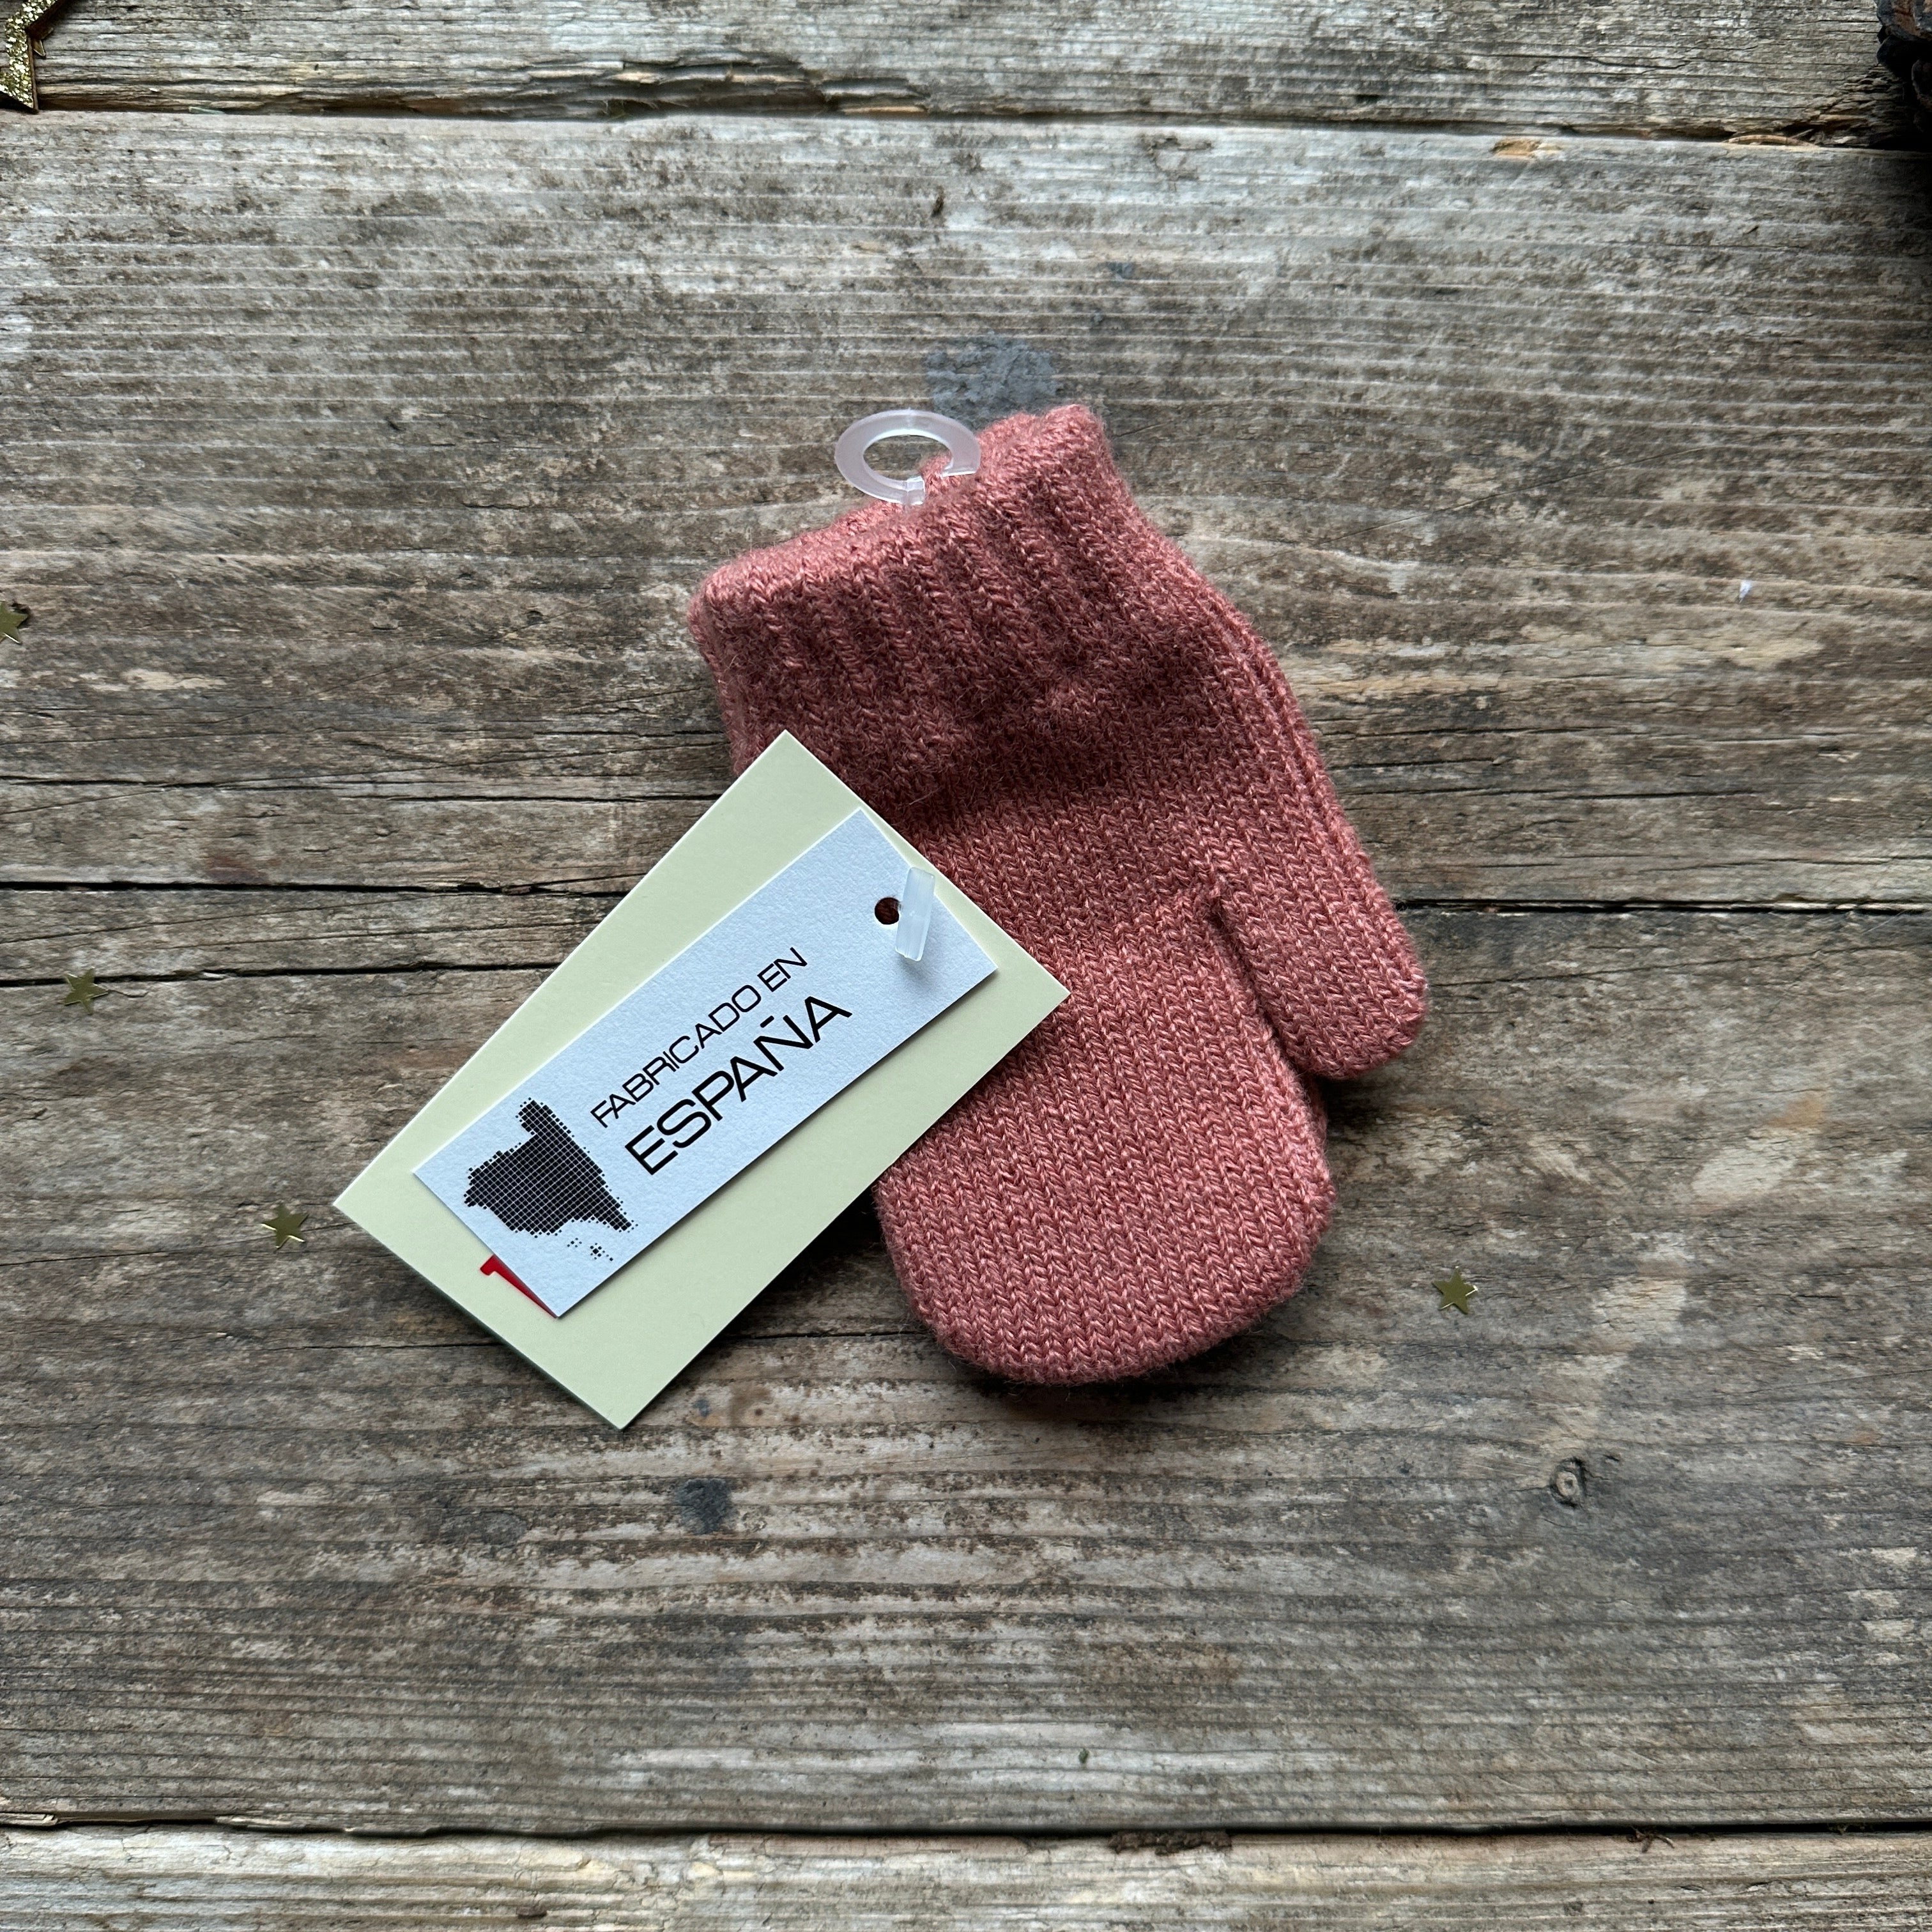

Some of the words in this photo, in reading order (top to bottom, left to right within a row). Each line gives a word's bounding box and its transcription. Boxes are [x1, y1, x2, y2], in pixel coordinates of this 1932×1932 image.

[590, 985, 762, 1128] FABRICADO
[757, 947, 808, 992] EN
[624, 995, 853, 1175] ESPAÑA
